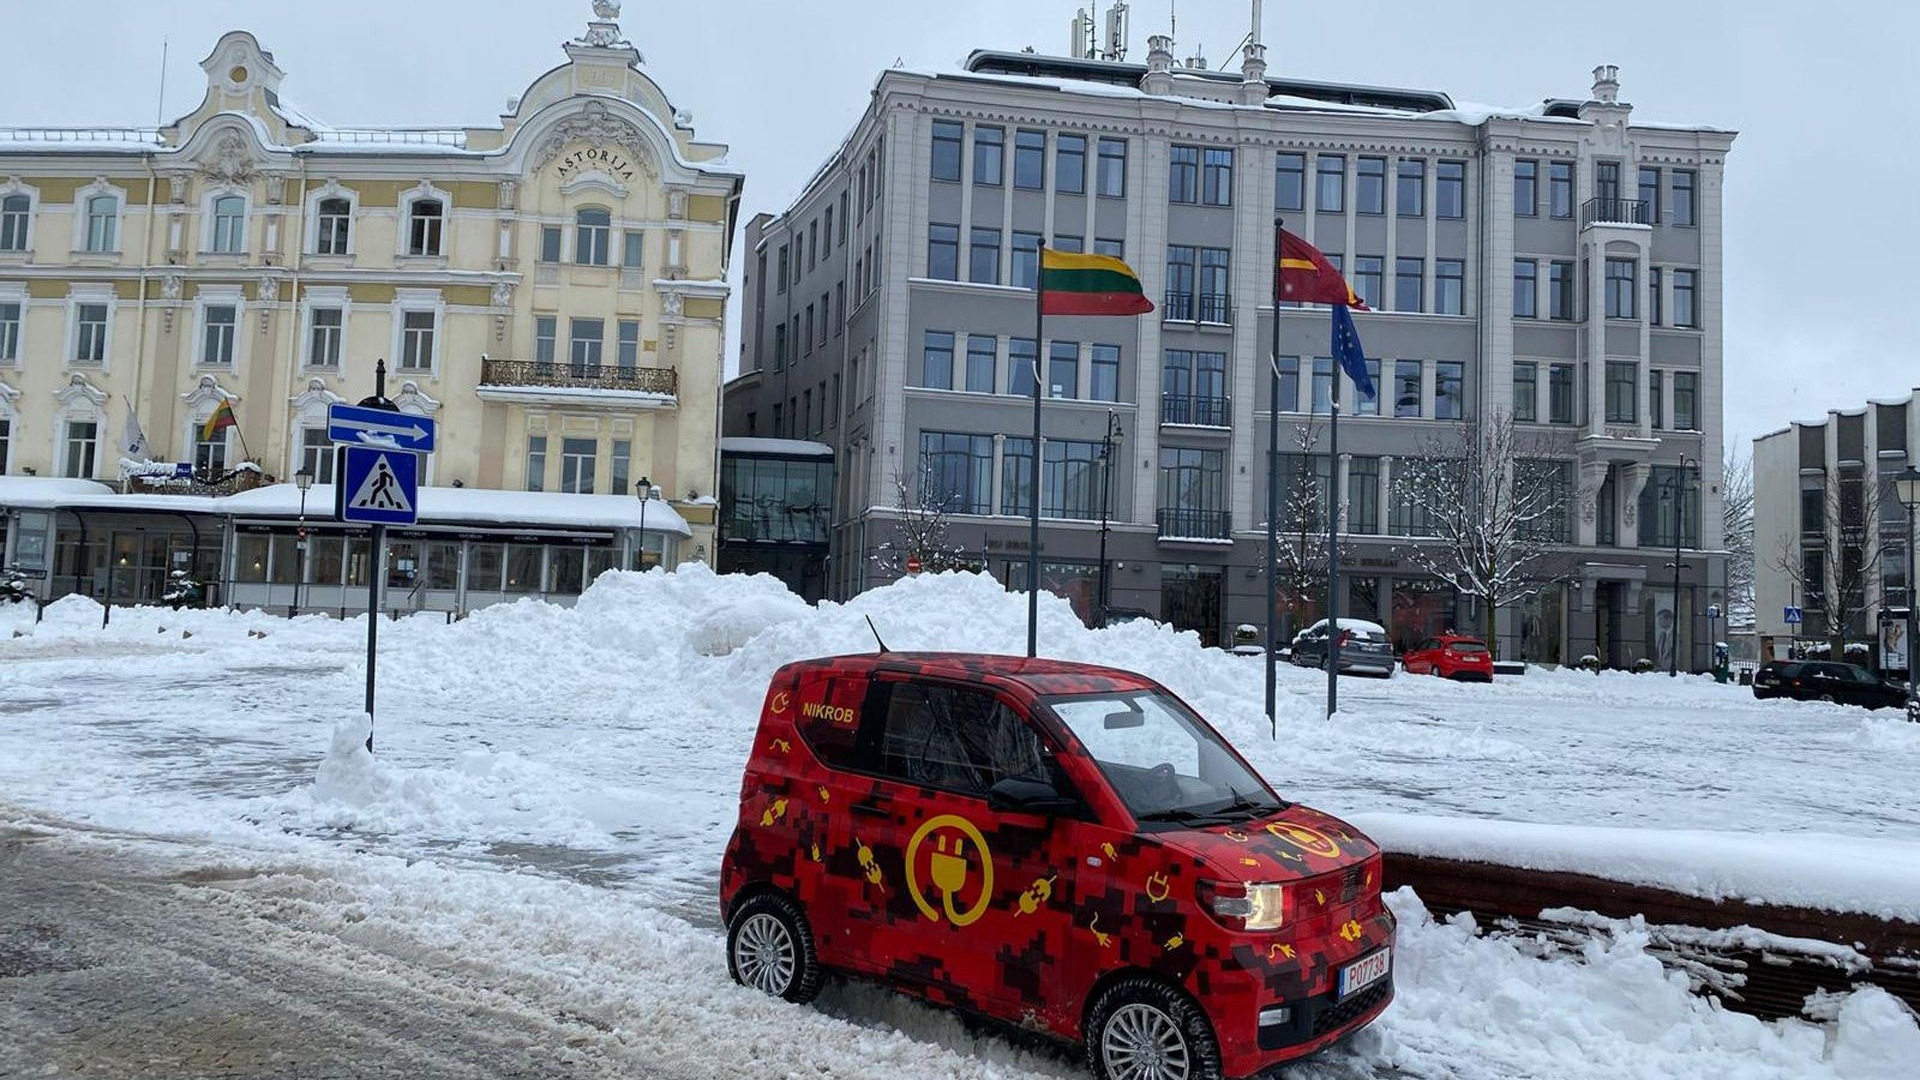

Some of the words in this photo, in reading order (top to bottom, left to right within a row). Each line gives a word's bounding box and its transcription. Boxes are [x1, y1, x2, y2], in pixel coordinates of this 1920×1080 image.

[557, 148, 633, 179] ASTORIJA
[802, 702, 854, 723] NIKROB
[1349, 953, 1385, 990] P07738
